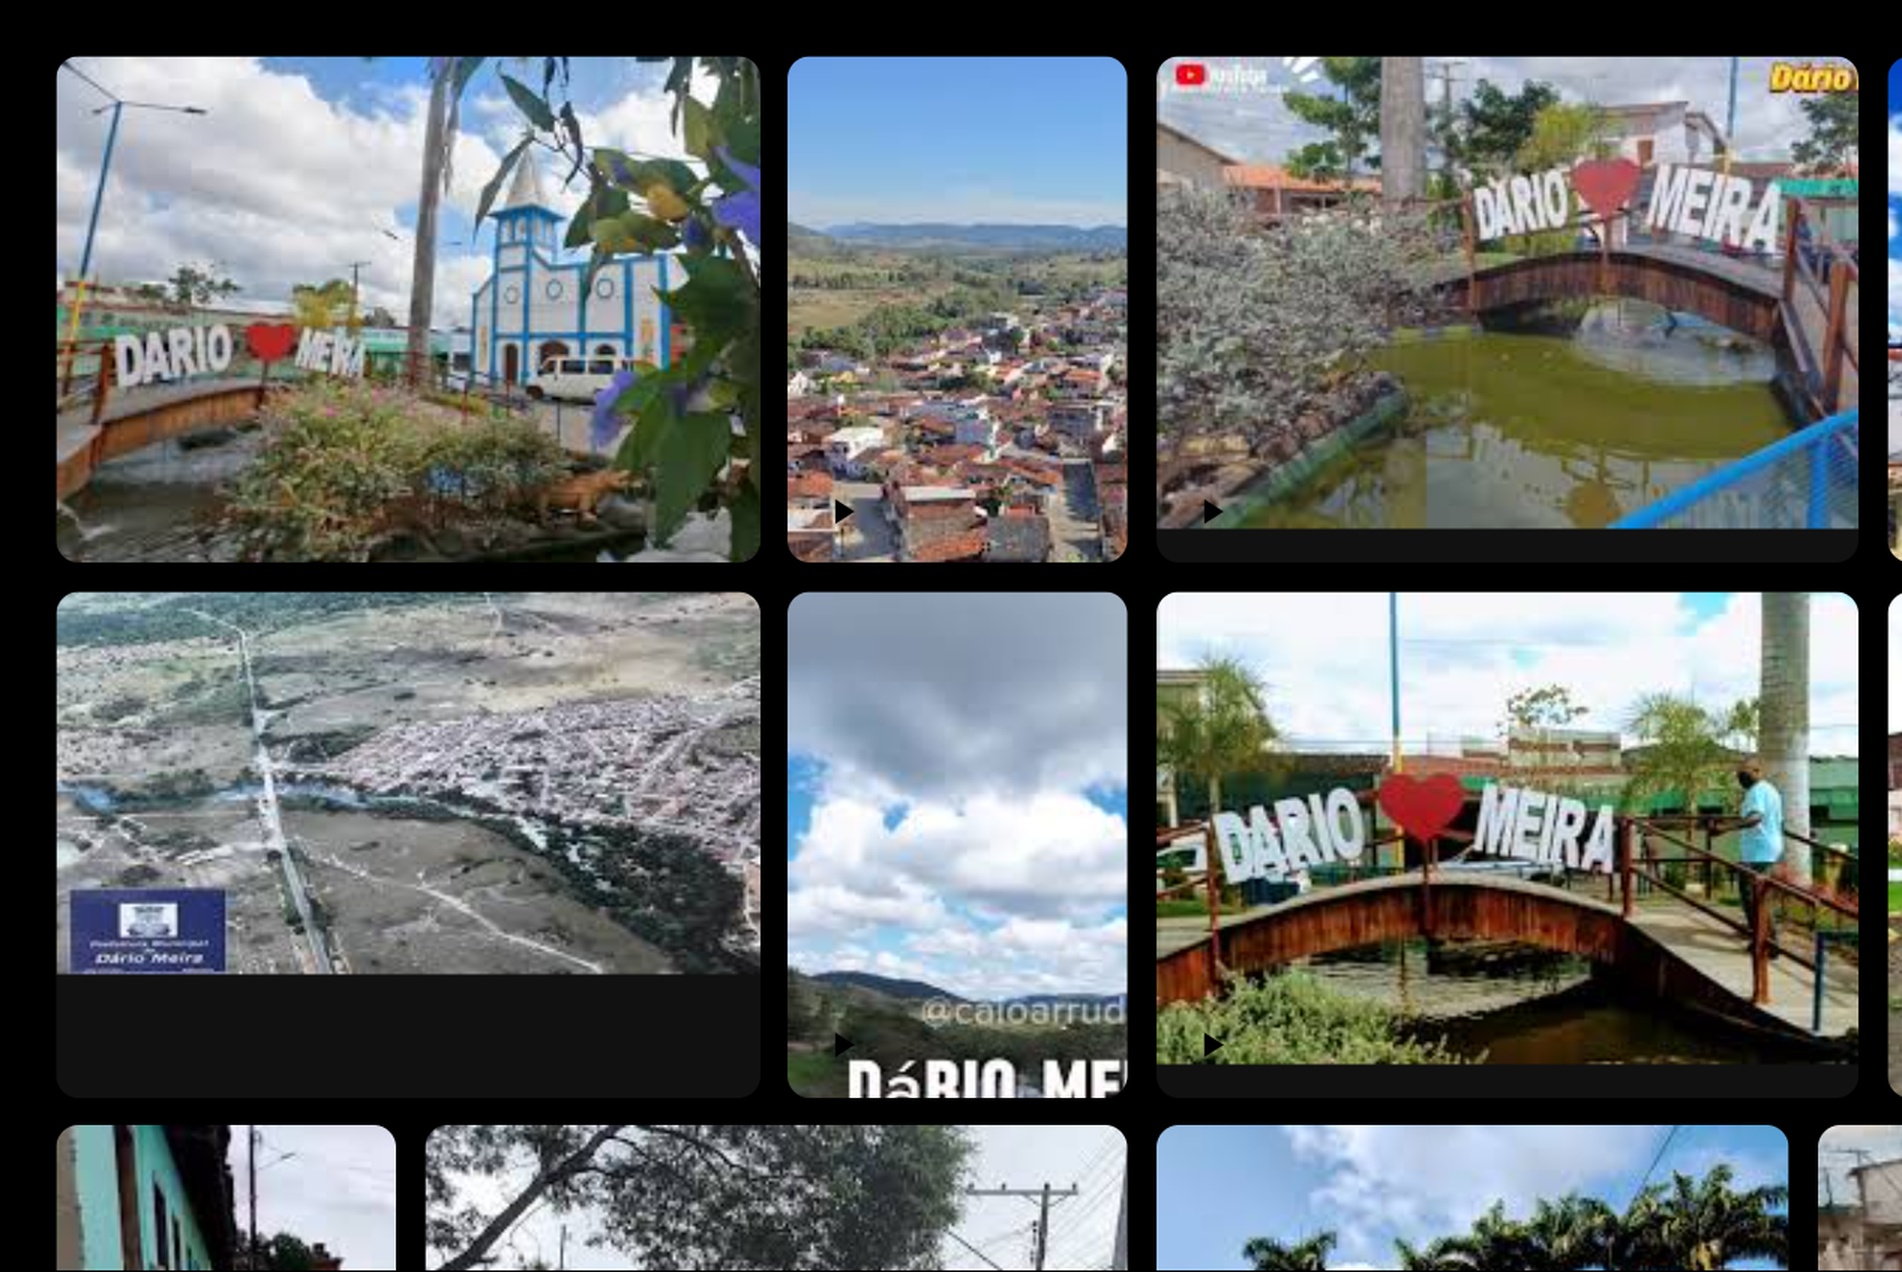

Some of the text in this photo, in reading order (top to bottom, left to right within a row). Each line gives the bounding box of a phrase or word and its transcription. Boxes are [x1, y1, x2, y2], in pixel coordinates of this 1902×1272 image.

[1474, 163, 1782, 252] DARIO MEIRA
[115, 324, 233, 387] DARIO
[1212, 782, 1614, 885] DARIO MEIRA
